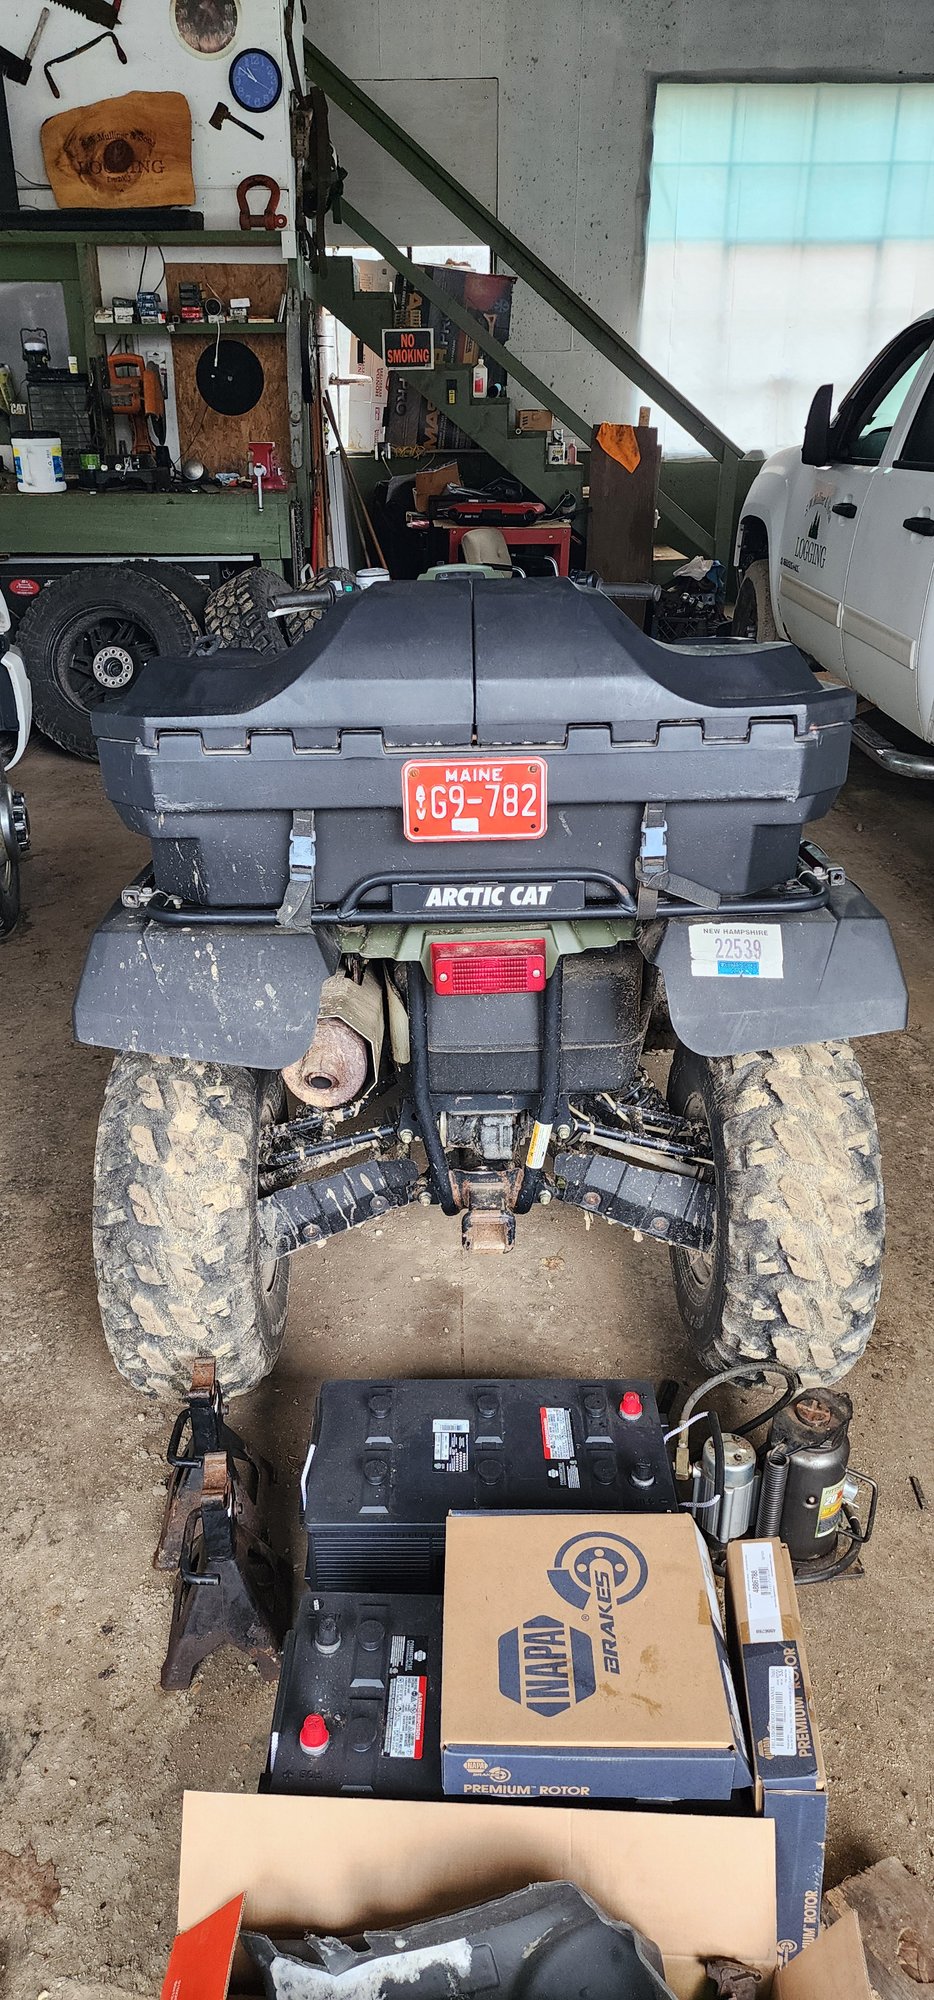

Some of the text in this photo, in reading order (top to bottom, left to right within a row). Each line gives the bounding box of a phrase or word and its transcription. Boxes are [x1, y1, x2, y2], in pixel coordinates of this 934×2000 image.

[78, 159, 165, 175] LOING
[400, 333, 415, 348] NO
[387, 348, 430, 364] SMOKING
[10, 402, 27, 415] CAT
[794, 536, 828, 569] LOGGING
[445, 767, 504, 783] MAINE
[430, 783, 537, 819] G9-782
[425, 886, 553, 907] ARCTIC CAT
[723, 928, 769, 936] HAMPSHIRE
[715, 938, 761, 960] 22539
[597, 1569, 621, 1675] BRAKES
[526, 1628, 568, 1699] NAPA
[467, 1761, 485, 1769] NAPA
[539, 1785, 591, 1796] ROTOR
[804, 1889, 819, 1923] ROTOR
